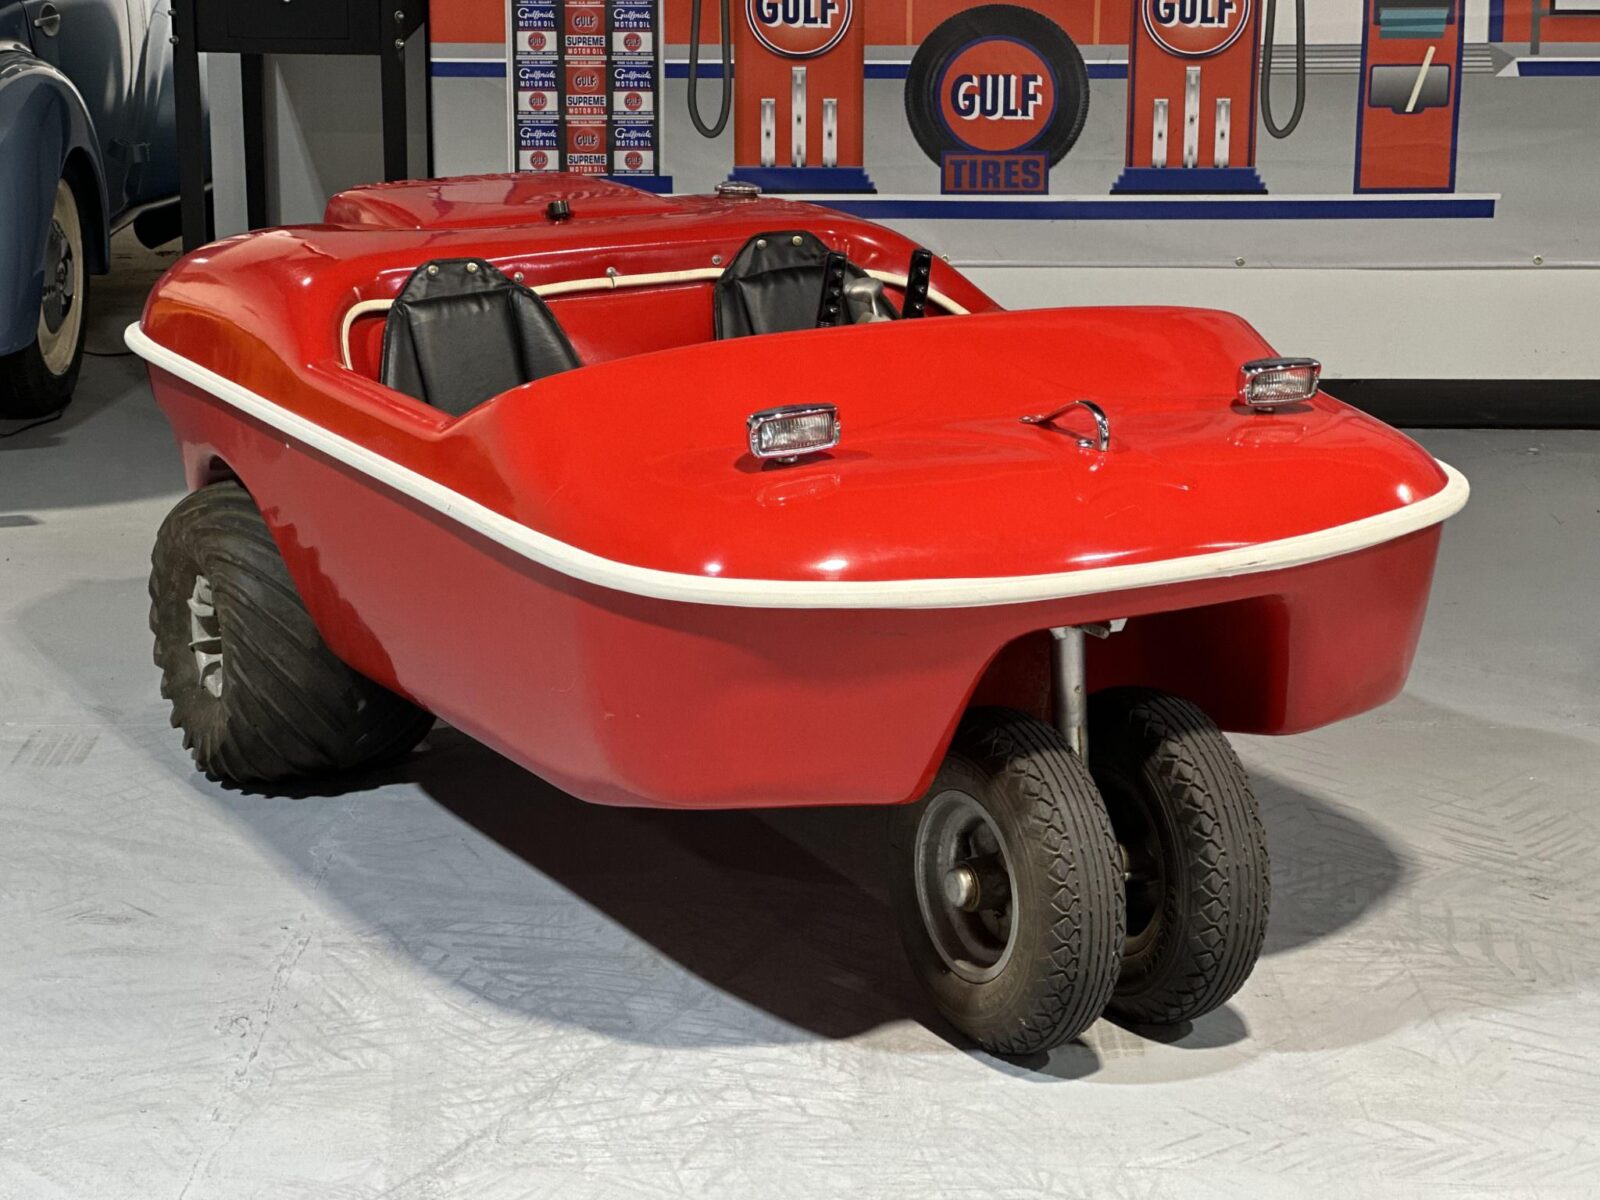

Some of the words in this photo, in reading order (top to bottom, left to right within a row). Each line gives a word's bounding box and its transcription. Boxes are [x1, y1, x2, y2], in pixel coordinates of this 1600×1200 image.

[756, 0, 839, 28] GULF
[1153, 0, 1236, 28] GULF
[575, 17, 596, 28] GULF
[567, 37, 604, 46] SUPREME
[575, 76, 597, 86] GULF
[567, 96, 604, 106] SUPREME
[951, 74, 1043, 120] GULF
[576, 135, 598, 146] GULF
[568, 155, 605, 164] SUPREME
[951, 159, 1041, 188] TIRES
